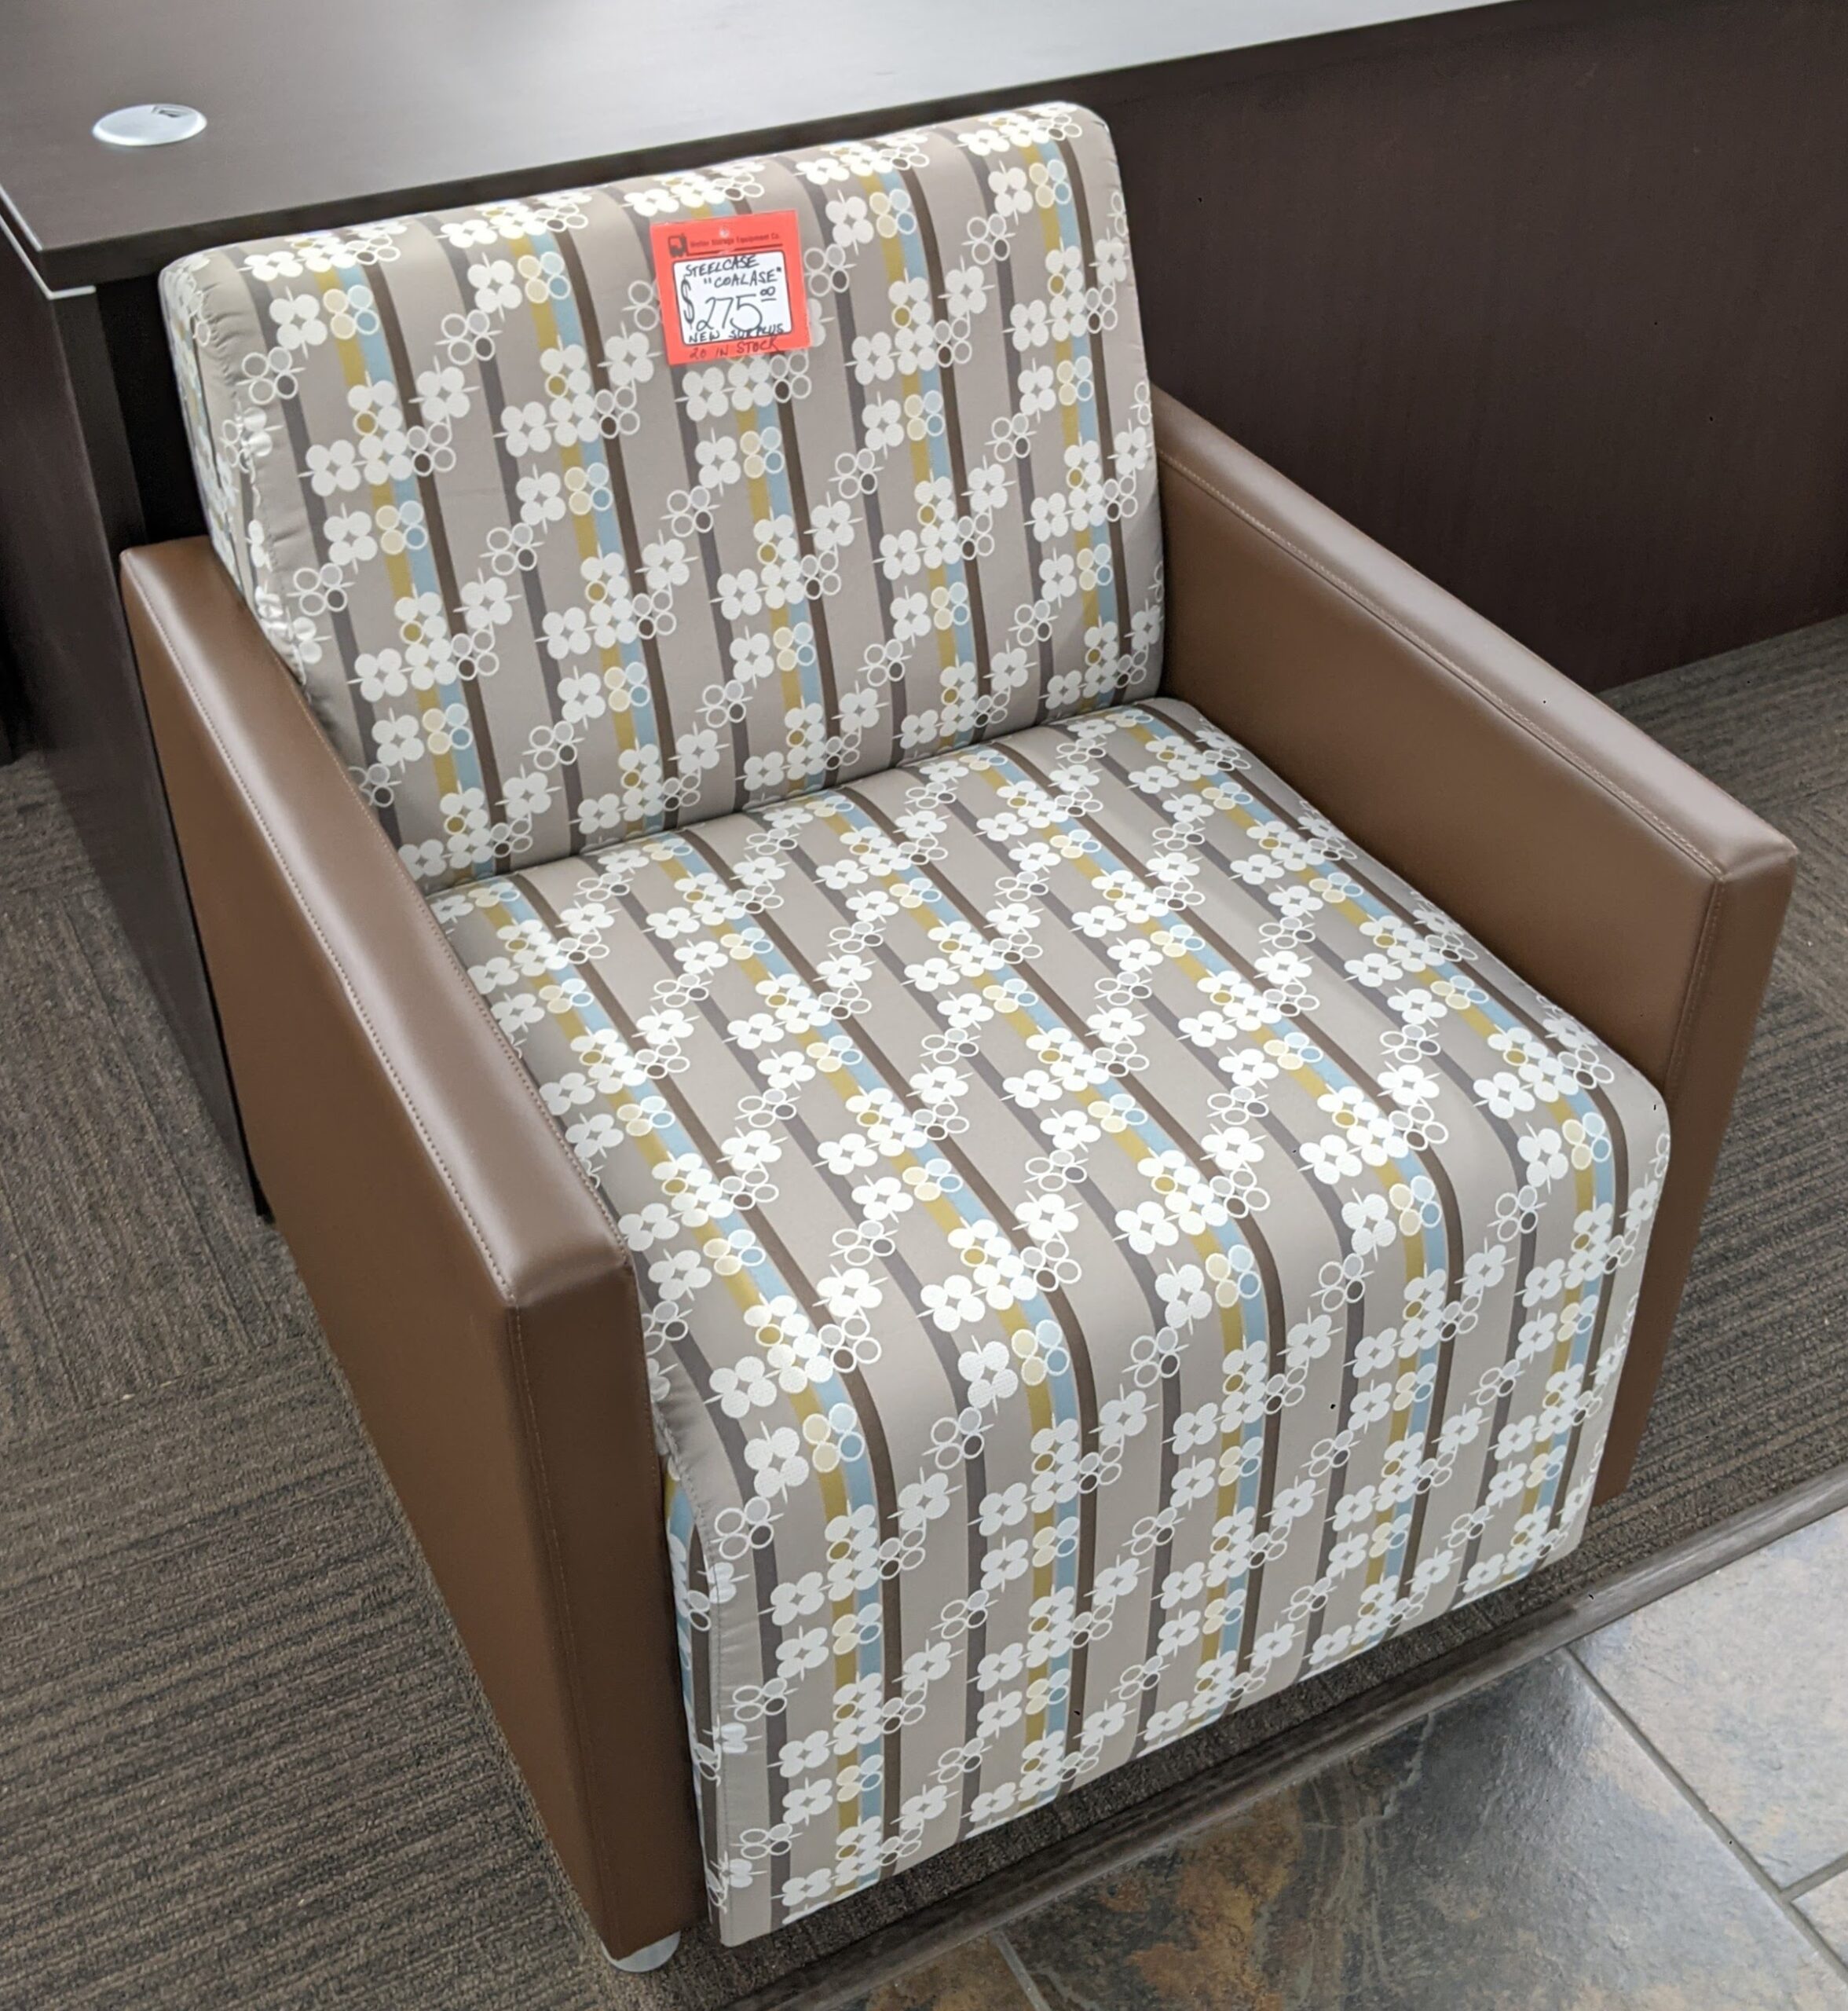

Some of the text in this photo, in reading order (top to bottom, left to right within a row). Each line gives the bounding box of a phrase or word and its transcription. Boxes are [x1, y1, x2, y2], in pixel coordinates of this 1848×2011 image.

[685, 255, 759, 277] STEELCASE
[689, 330, 720, 342] NEW
[715, 344, 729, 356] IN
[737, 335, 779, 353] STOCK
